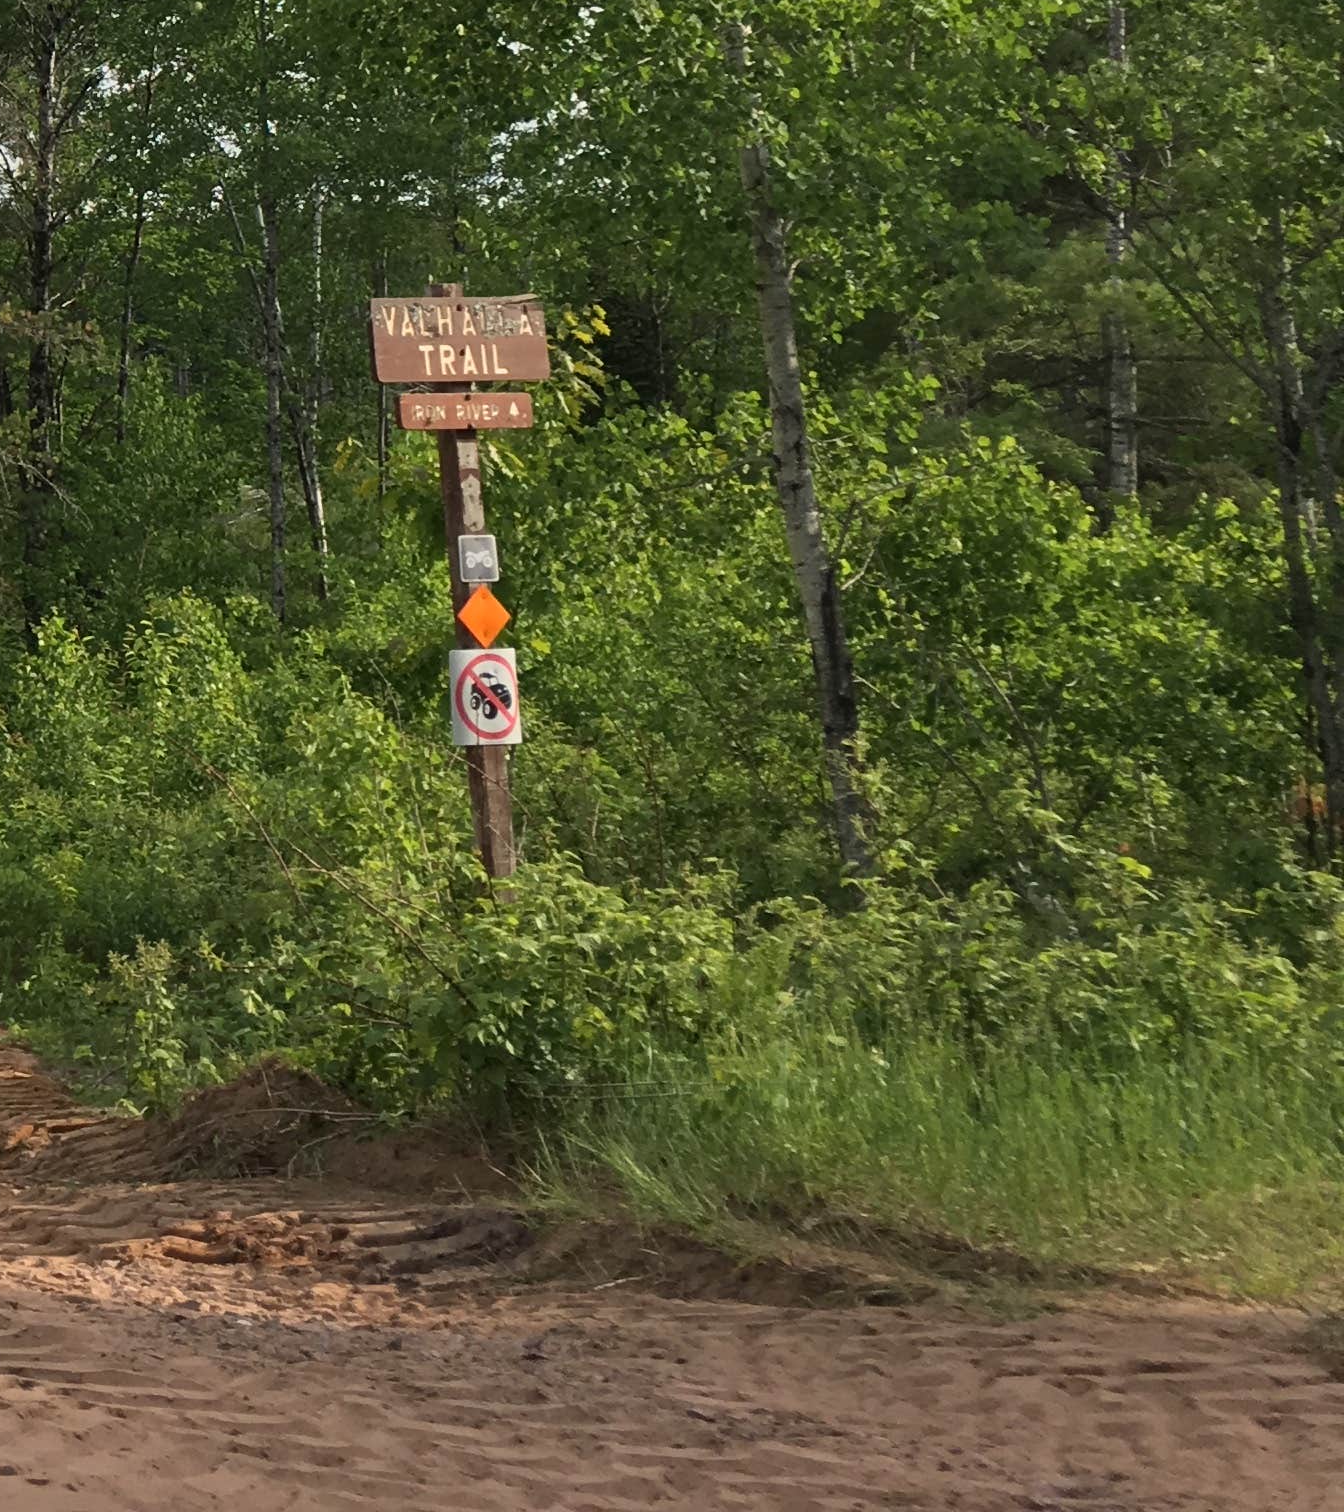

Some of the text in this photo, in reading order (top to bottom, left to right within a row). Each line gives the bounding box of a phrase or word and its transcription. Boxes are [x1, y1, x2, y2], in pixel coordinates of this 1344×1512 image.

[419, 345, 509, 375] TRAIL
[411, 404, 500, 421] IRON RIVER
